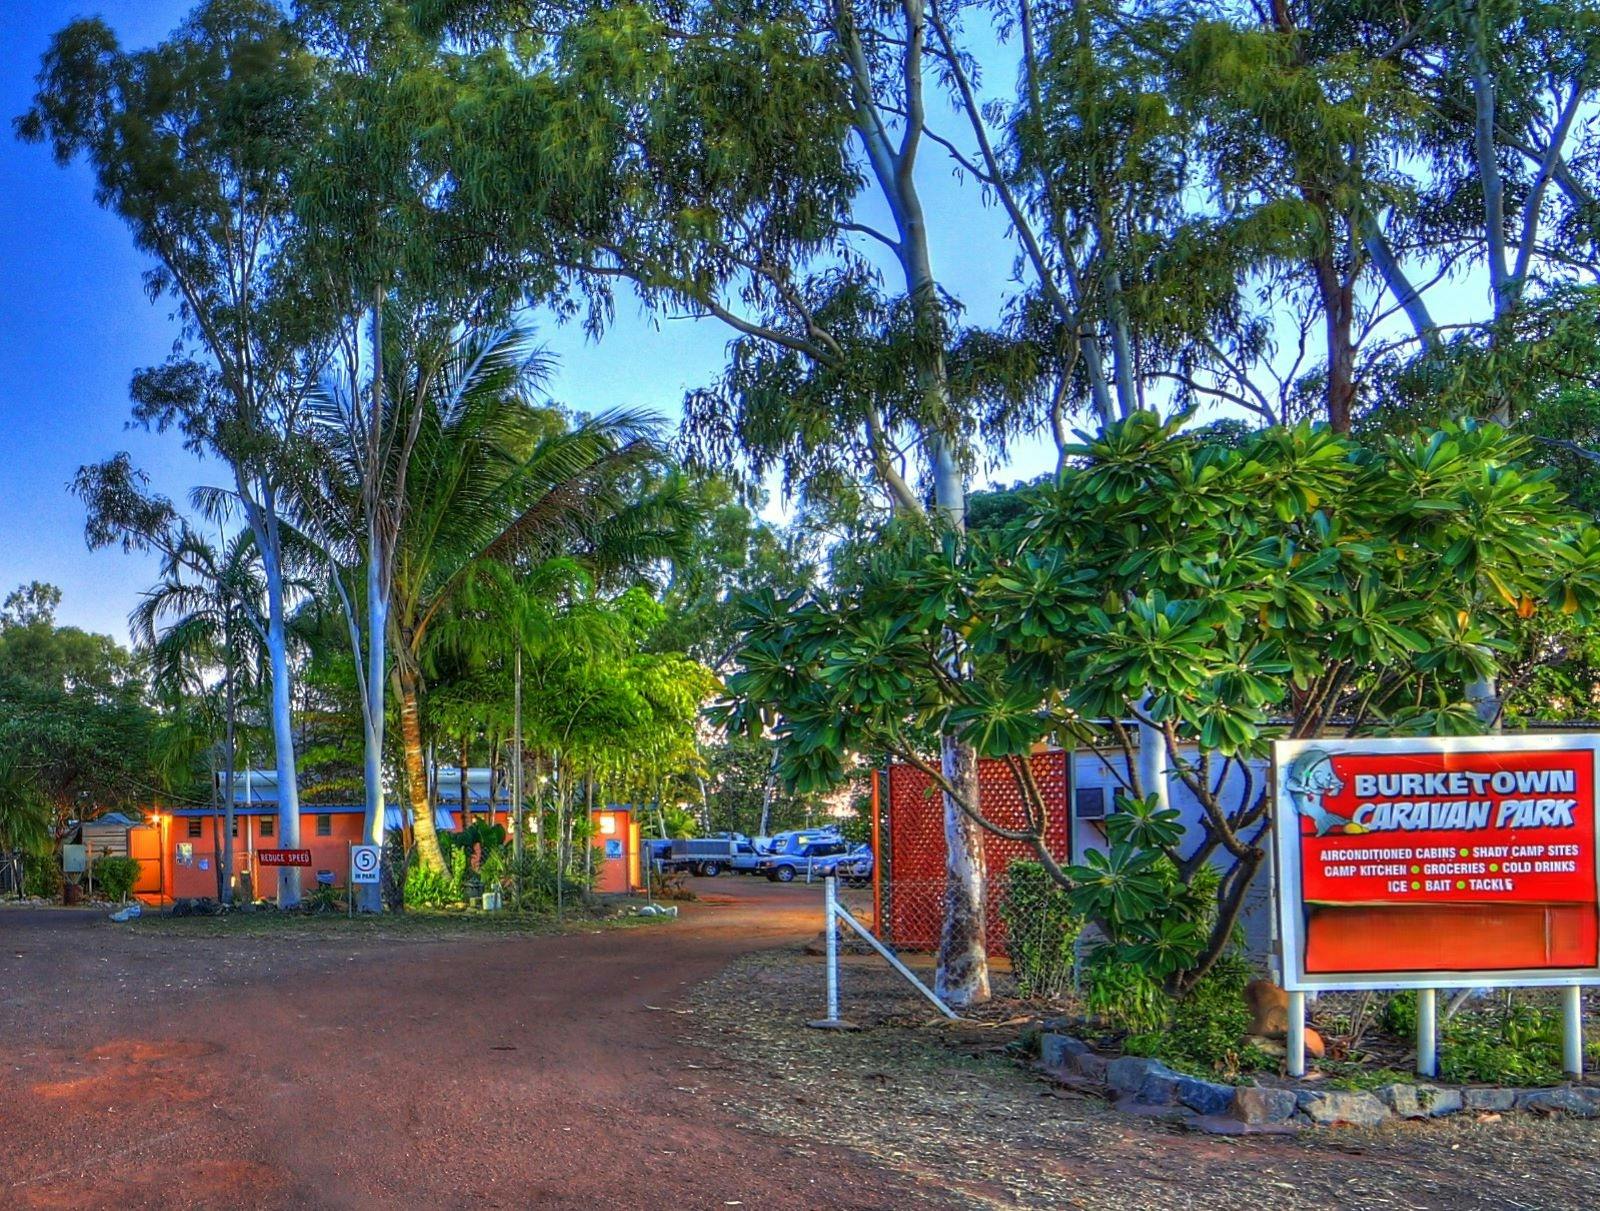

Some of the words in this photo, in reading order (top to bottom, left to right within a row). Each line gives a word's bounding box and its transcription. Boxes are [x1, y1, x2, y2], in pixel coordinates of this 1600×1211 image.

[1354, 769, 1576, 798] BURKETOWN
[1352, 800, 1492, 831] CARAVAN
[1495, 798, 1577, 829] PARK
[260, 853, 284, 863] REDUCE
[288, 853, 310, 863] SPEED
[361, 853, 370, 867] 5
[1320, 848, 1412, 861] AIRCONDITIONED
[1415, 847, 1456, 859] CABINS
[1472, 846, 1508, 858] SHADY
[1511, 845, 1545, 857] CAMP
[1547, 844, 1579, 856] SITES
[1324, 865, 1357, 877] CAMP
[1360, 864, 1407, 876] KITCHEN
[1423, 862, 1486, 875] GROCERIES
[1502, 861, 1532, 873] COLD
[1535, 860, 1576, 872] DRINKS
[1388, 880, 1408, 892] ICE
[1425, 879, 1452, 892] BAIT
